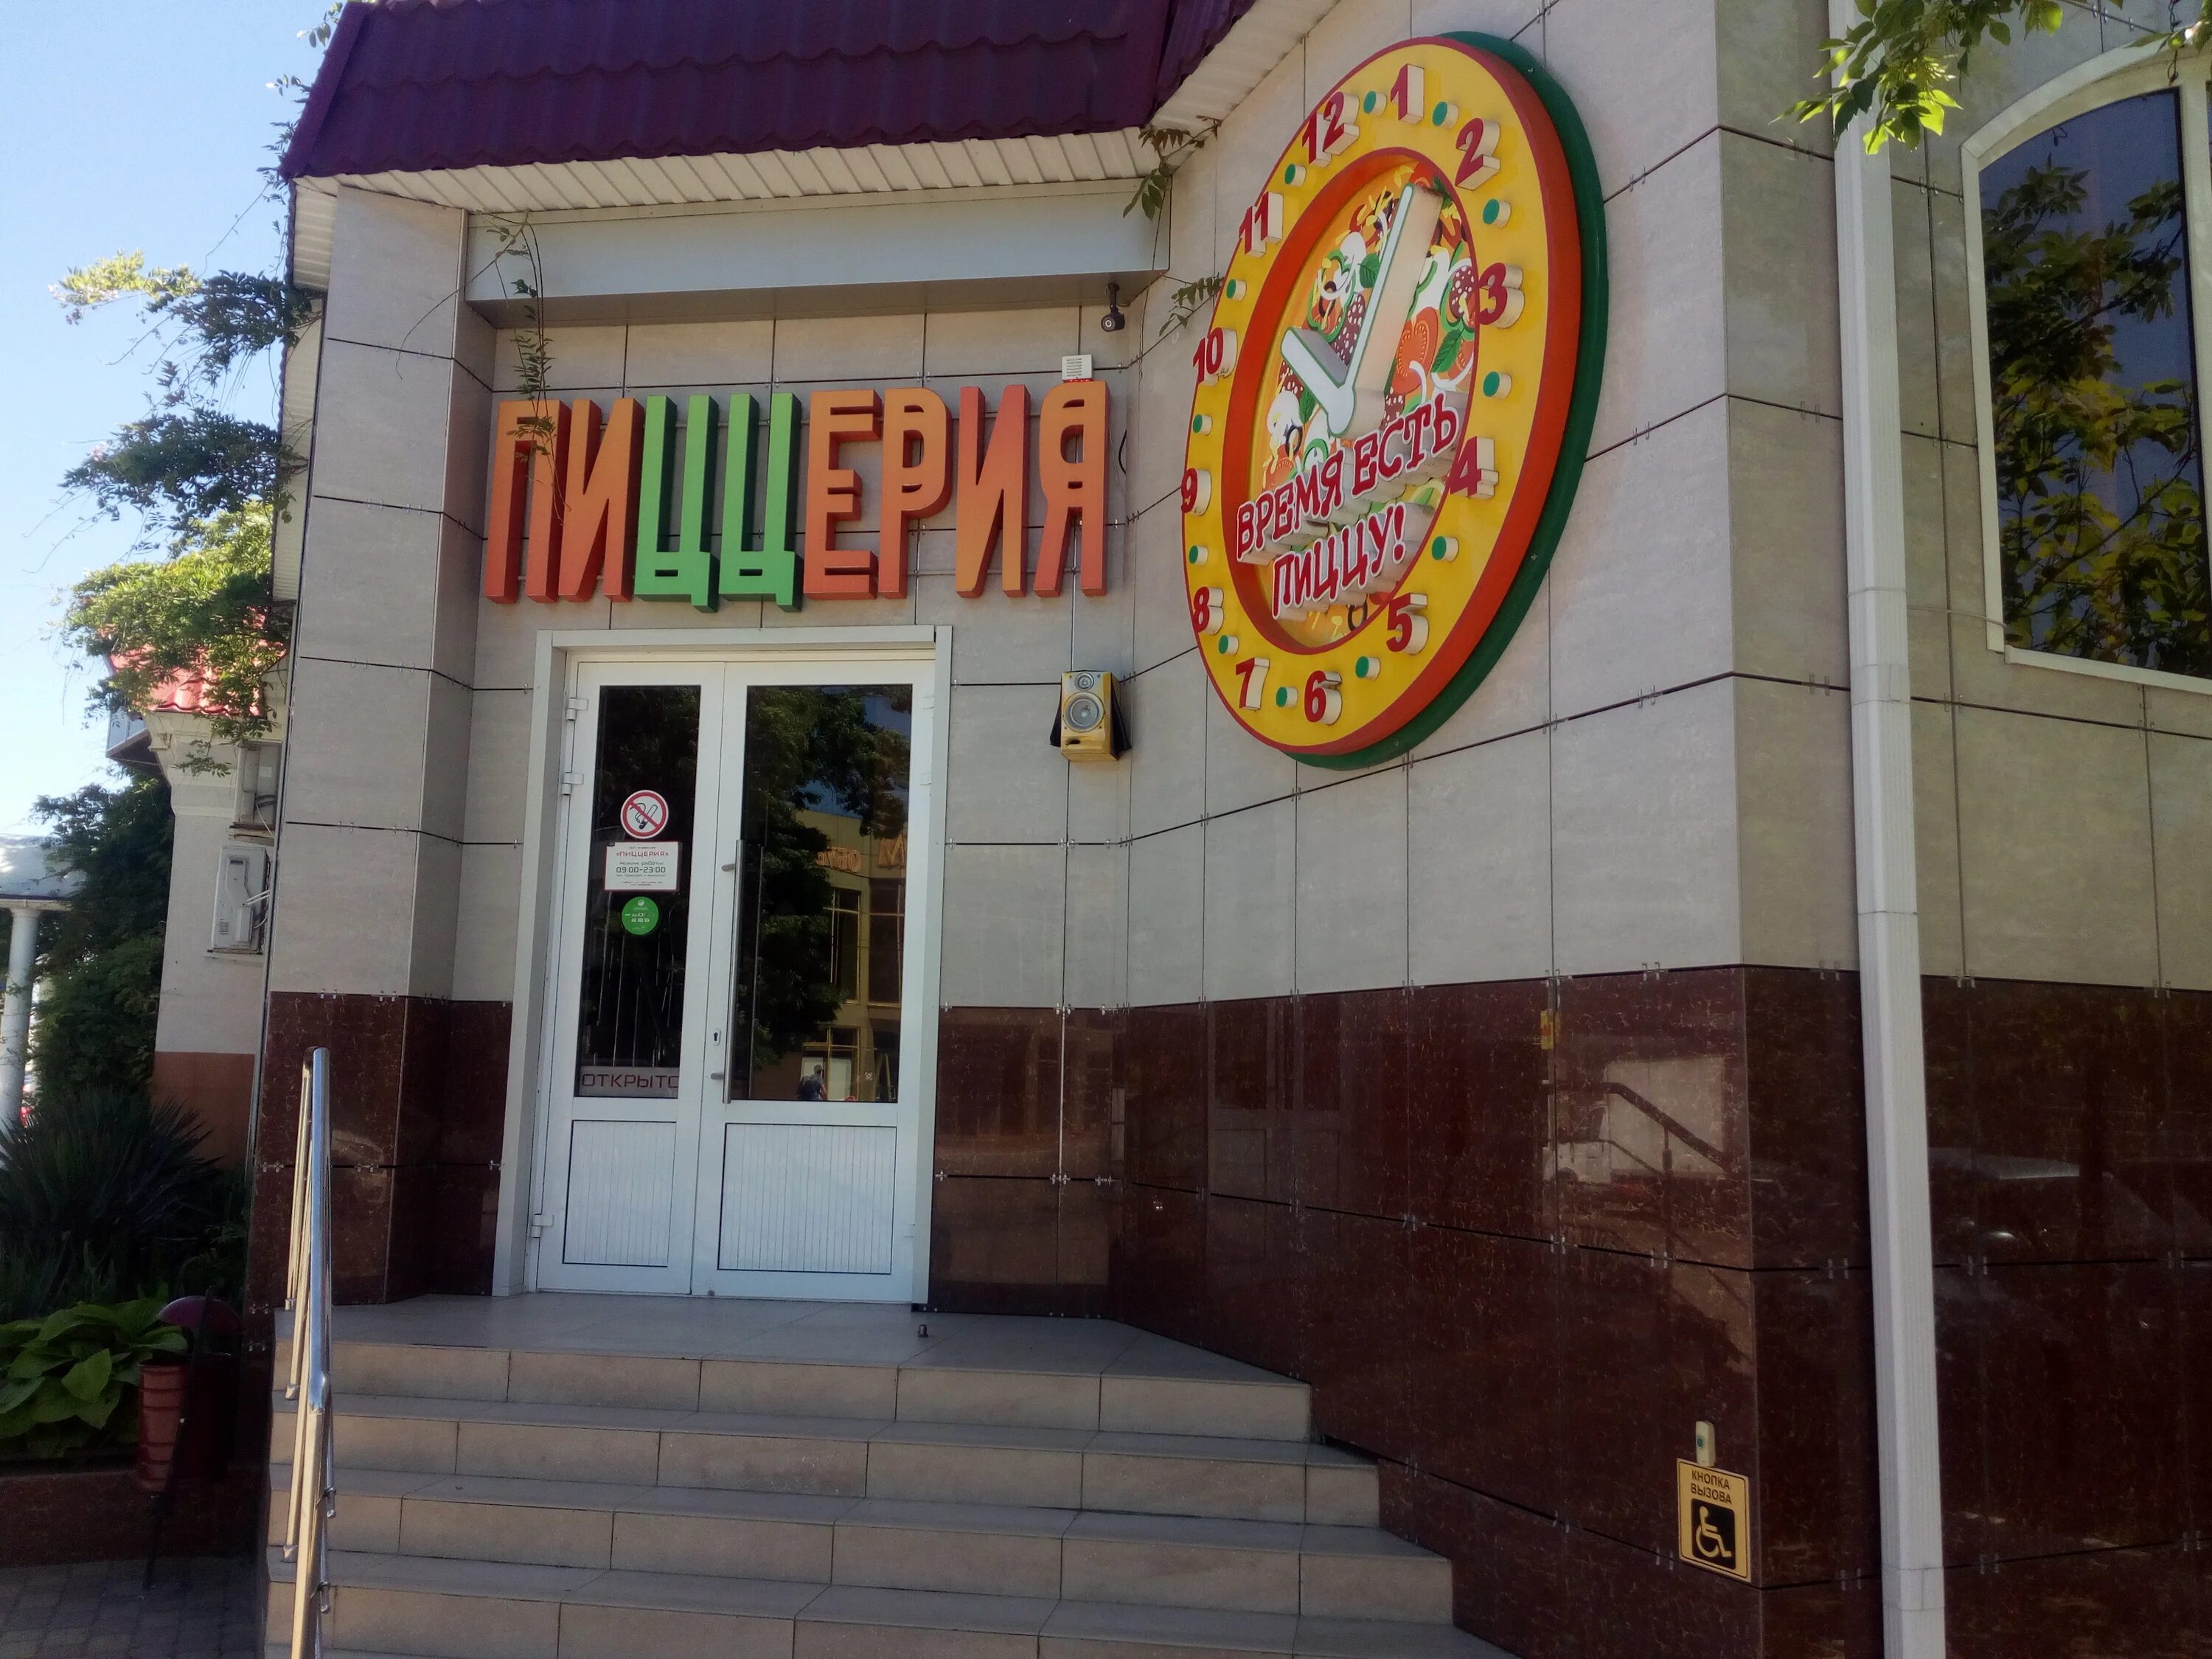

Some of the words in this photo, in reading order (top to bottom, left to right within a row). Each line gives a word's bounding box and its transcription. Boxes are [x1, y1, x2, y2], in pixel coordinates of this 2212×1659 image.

[1391, 64, 1414, 122] 1
[1302, 91, 1349, 166] 12
[1455, 118, 1489, 189] 2
[1239, 192, 1274, 256] 11
[1478, 262, 1512, 327] 3
[1193, 327, 1228, 383] 10
[1180, 469, 1203, 514] 9
[1237, 449, 1344, 561] ВРЕМЯ
[1352, 392, 1458, 498] ЕСТЬ
[1448, 437, 1488, 496] 4
[485, 380, 1110, 613] ПИЦЦЕРИЯ
[1273, 503, 1406, 619] ПИЦЦУ!
[1193, 587, 1215, 633] 8
[1386, 594, 1418, 653] 5
[1235, 658, 1260, 709] 7
[1304, 671, 1332, 723] 6
[1691, 1470, 1730, 1489] КНОПКА
[1691, 1483, 1731, 1504] ВЫЗОВА
